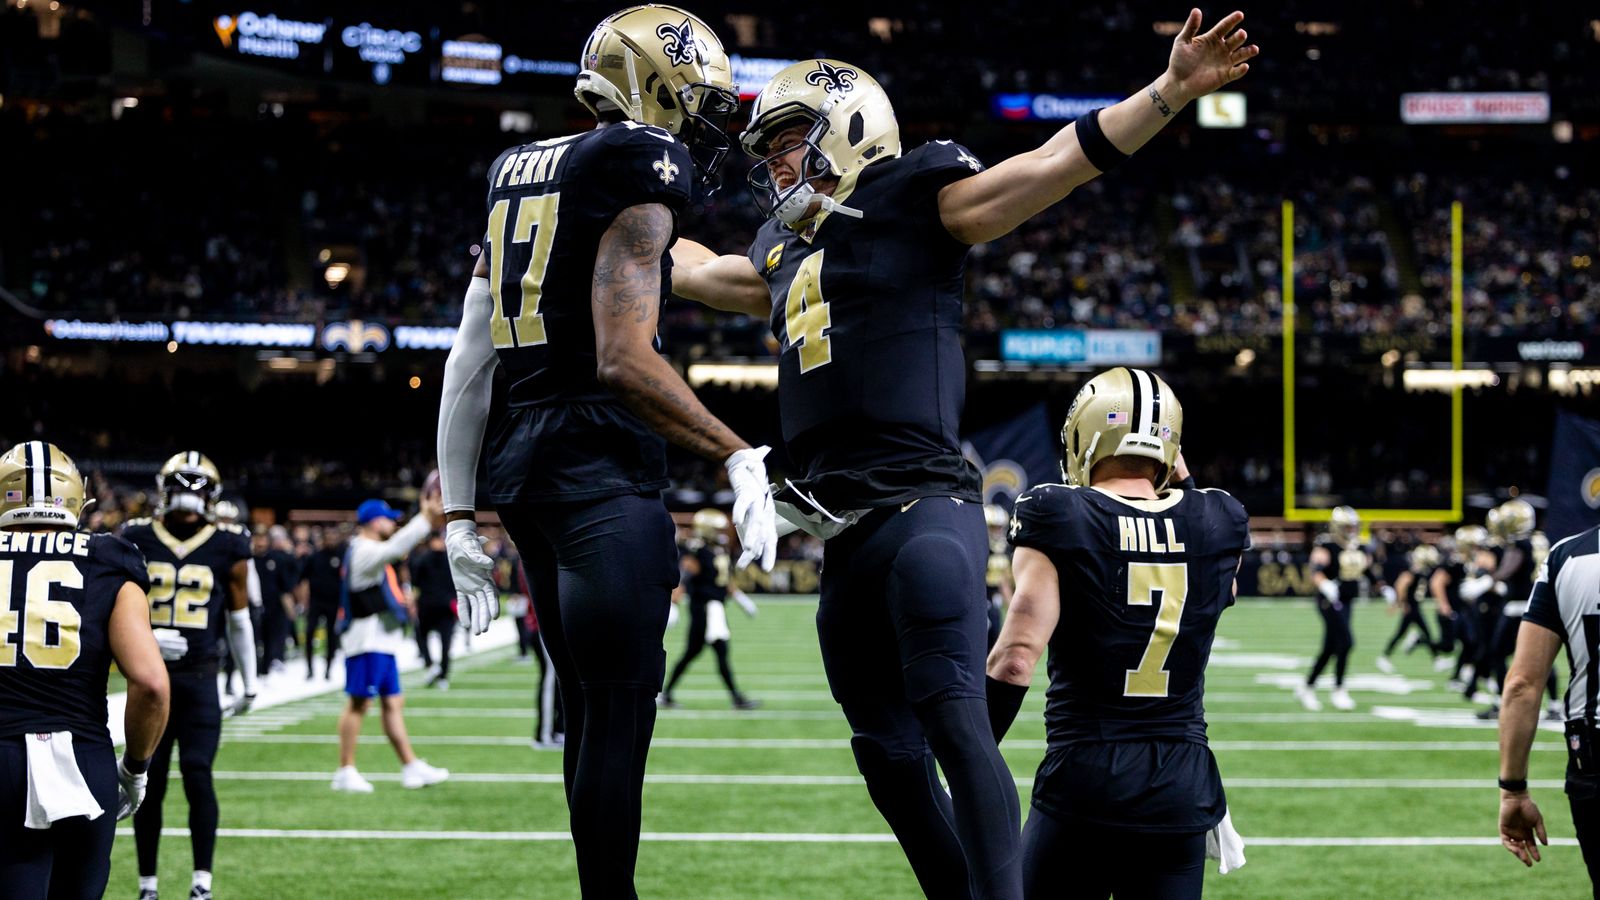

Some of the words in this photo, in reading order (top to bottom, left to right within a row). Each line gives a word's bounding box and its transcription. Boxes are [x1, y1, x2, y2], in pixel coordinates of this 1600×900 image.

[496, 144, 570, 188] PERRY
[487, 191, 560, 349] 17
[785, 248, 832, 374] 4
[1118, 516, 1186, 553] HILL
[149, 561, 215, 630] 22
[1123, 562, 1188, 697] 7
